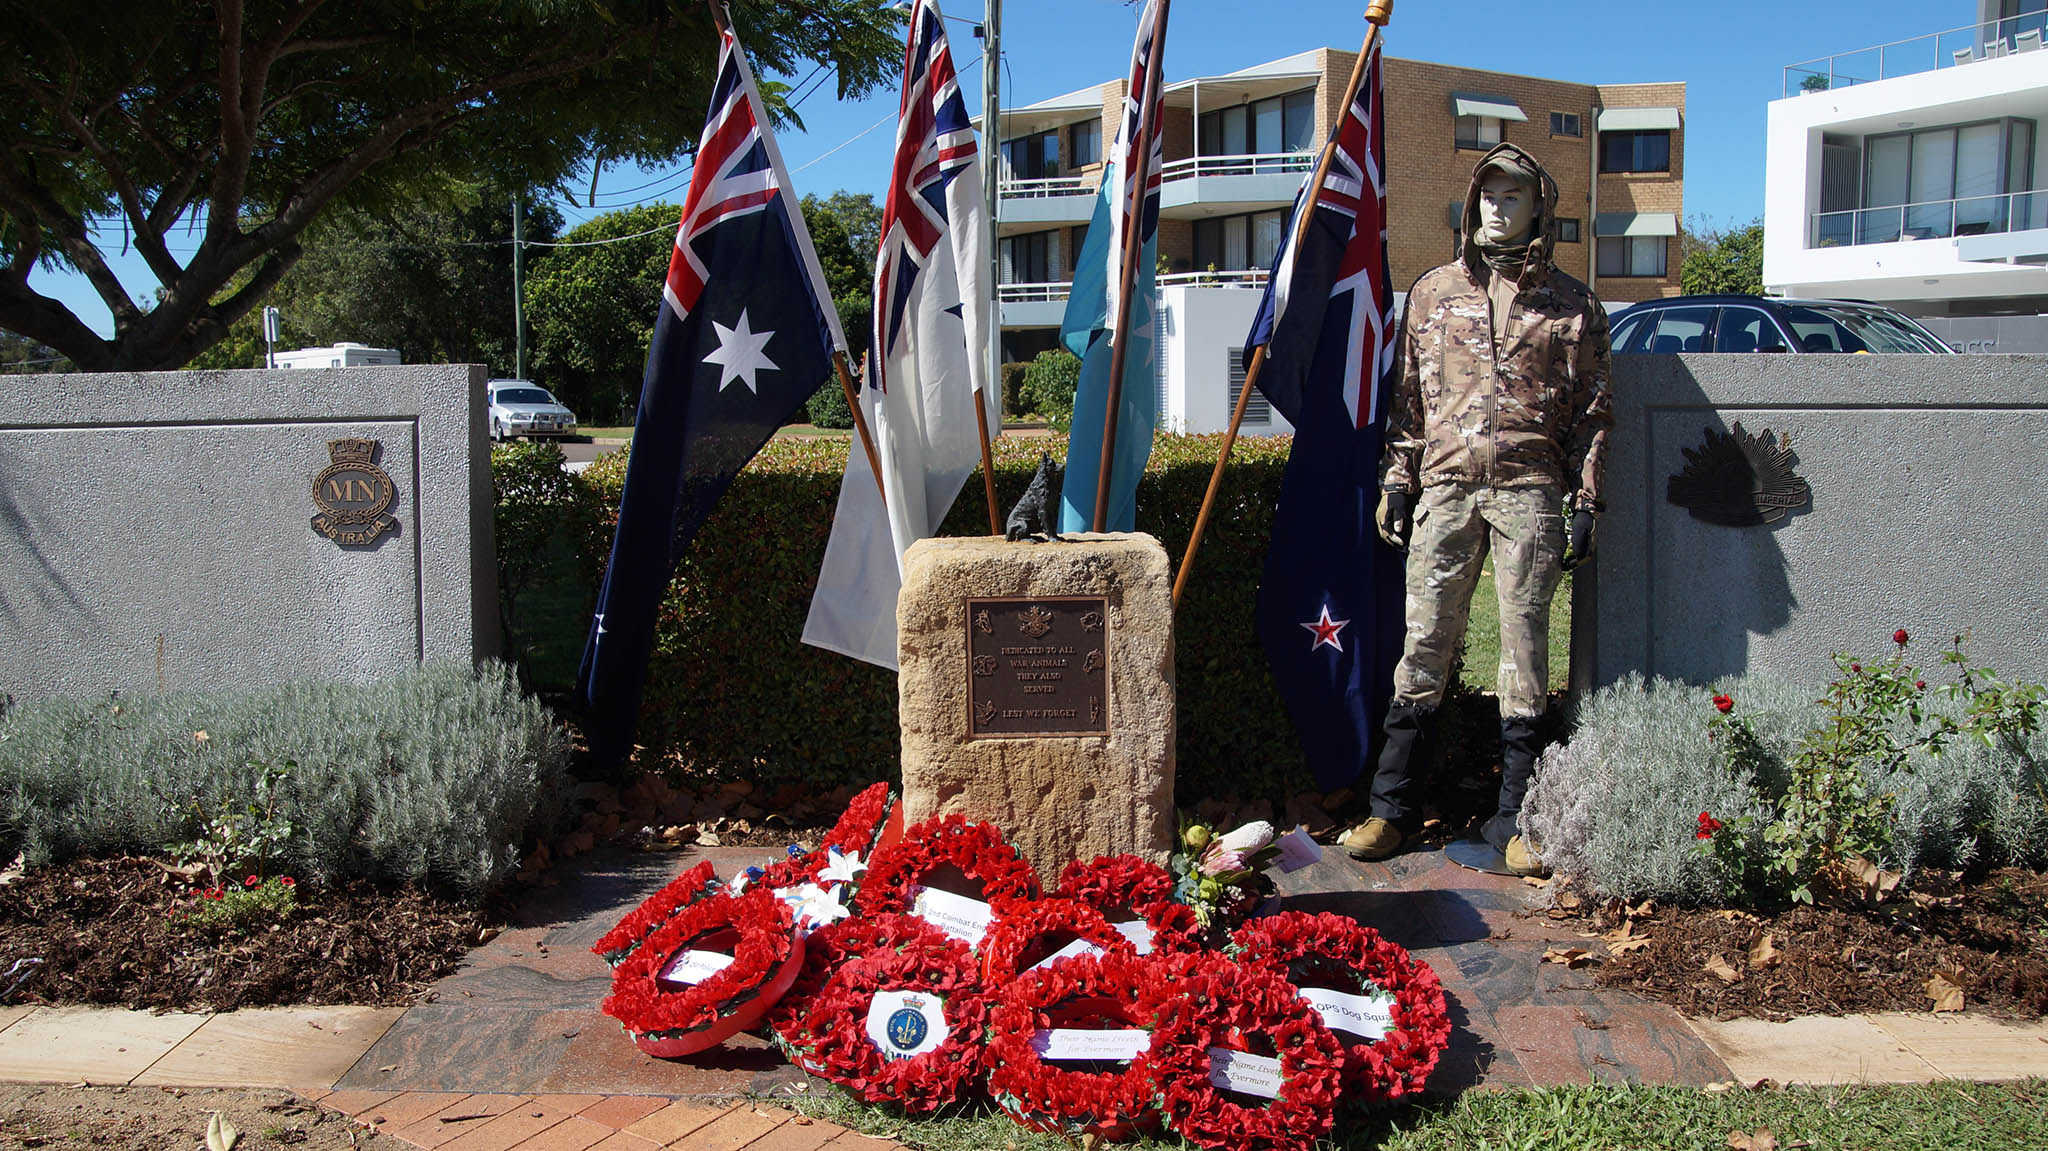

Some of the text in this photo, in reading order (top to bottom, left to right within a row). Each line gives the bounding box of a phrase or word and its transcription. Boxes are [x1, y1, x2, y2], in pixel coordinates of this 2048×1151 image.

[328, 479, 378, 502] MN
[315, 516, 386, 544] AUSTRALIA
[1001, 647, 1044, 655] DEDICATED
[1059, 646, 1074, 654] ALL
[1009, 659, 1068, 667] WAR ANIMALS
[1016, 672, 1061, 680] THEY ALSO
[1023, 685, 1054, 693] SERVED
[1002, 709, 1076, 718] LEST WE FORGET
[942, 912, 970, 927] Combat
[941, 922, 973, 938] Battalion
[1341, 1006, 1362, 1021] Dog
[1363, 1012, 1391, 1023] Squa
[1232, 1060, 1256, 1070] Name
[1230, 1072, 1270, 1087] Evermore
